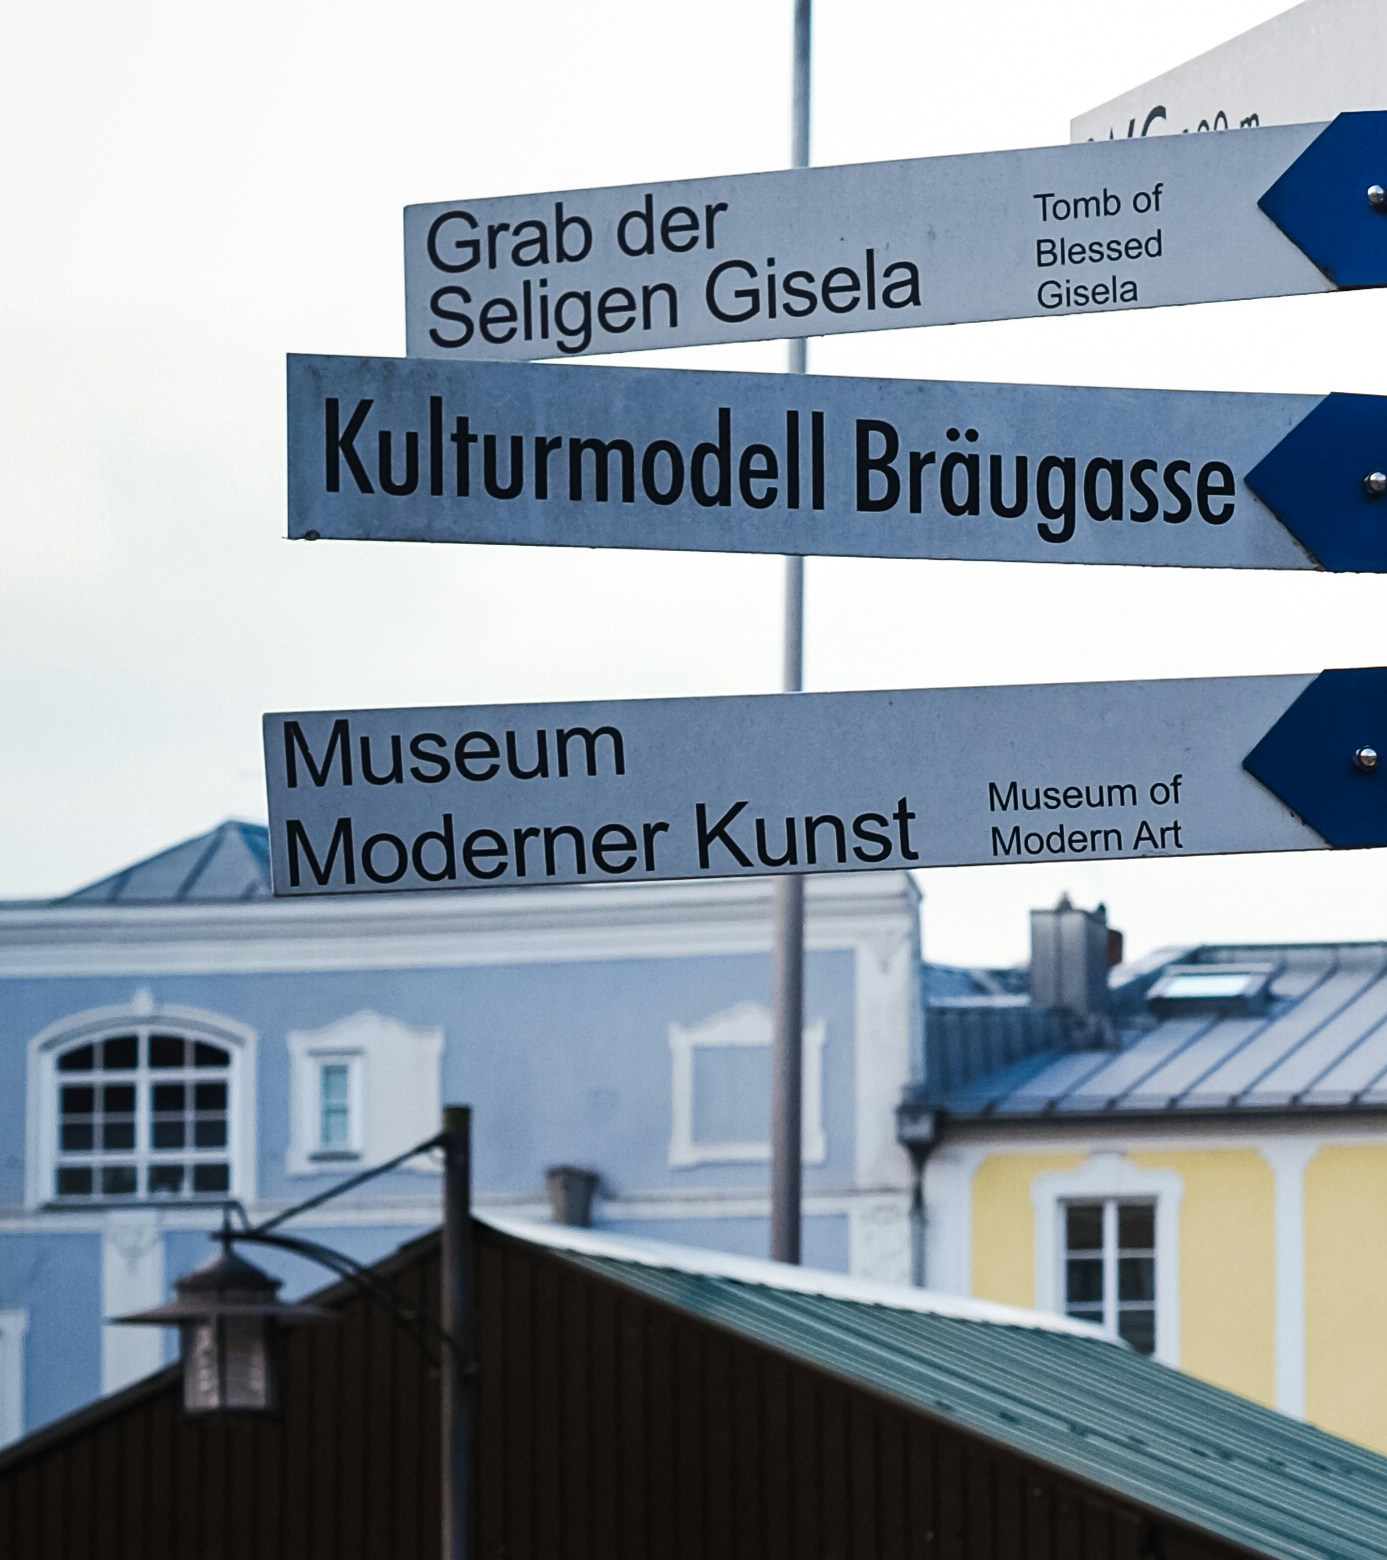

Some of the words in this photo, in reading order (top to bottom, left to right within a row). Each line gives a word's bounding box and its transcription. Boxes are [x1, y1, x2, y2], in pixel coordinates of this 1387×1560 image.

[1033, 188, 1121, 221] Tomb
[1133, 183, 1163, 213] of
[427, 202, 592, 273] Grab
[617, 194, 728, 256] der
[1037, 229, 1161, 267] Blessed
[429, 278, 677, 354] Seligen
[706, 249, 921, 323] Gisela
[1038, 275, 1137, 309] Gisela
[325, 396, 824, 510] Kulturmodell
[856, 419, 1235, 543] Bräugasse
[284, 719, 625, 788] Museum
[989, 782, 1137, 811] Museum
[1150, 774, 1182, 805] of
[286, 814, 669, 887] Moderner
[696, 797, 919, 869] Kunst
[992, 824, 1122, 856] Modern
[1133, 820, 1183, 850] Art
